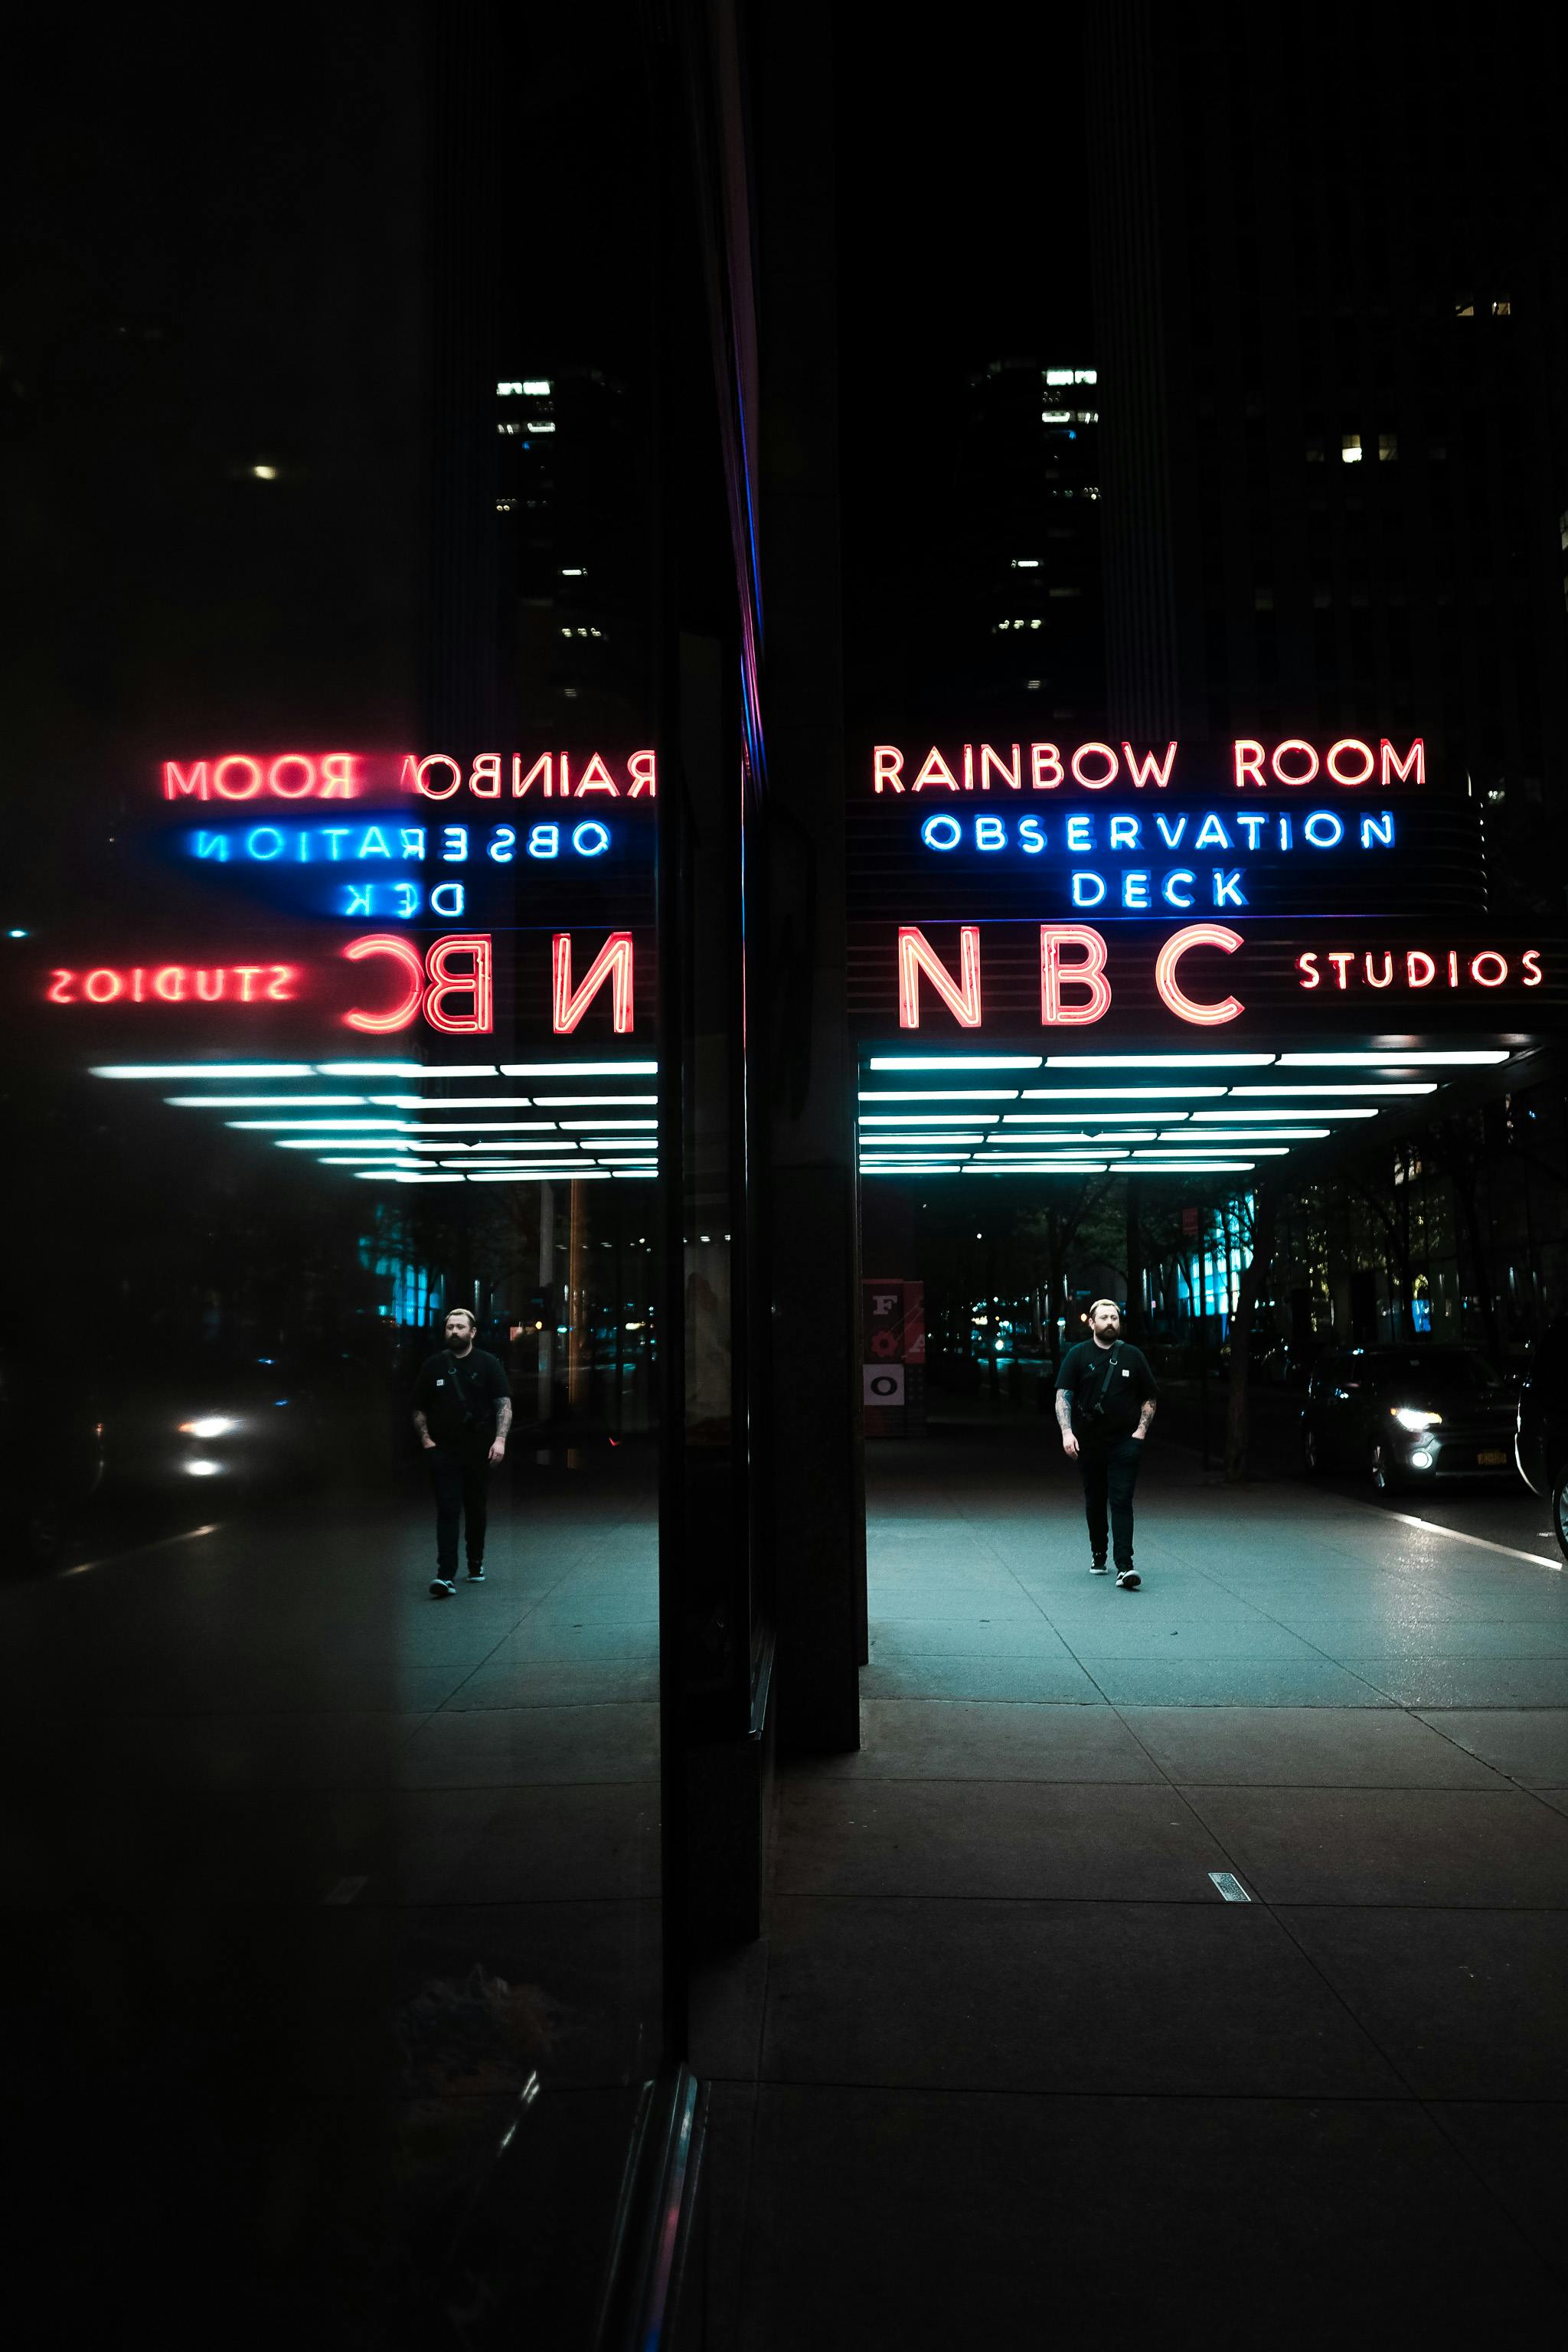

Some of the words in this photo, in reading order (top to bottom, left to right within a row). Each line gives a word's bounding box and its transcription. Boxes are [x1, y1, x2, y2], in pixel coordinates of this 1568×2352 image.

[874, 741, 1178, 793] RAINBOW
[1234, 738, 1426, 788] ROOM
[921, 809, 1395, 853] OBSERVATION
[1072, 869, 1250, 908] DECK
[898, 923, 1246, 1029] NBC
[1298, 950, 1542, 989] STUDIOS
[872, 1295, 898, 1315] F
[871, 1376, 897, 1396] O
